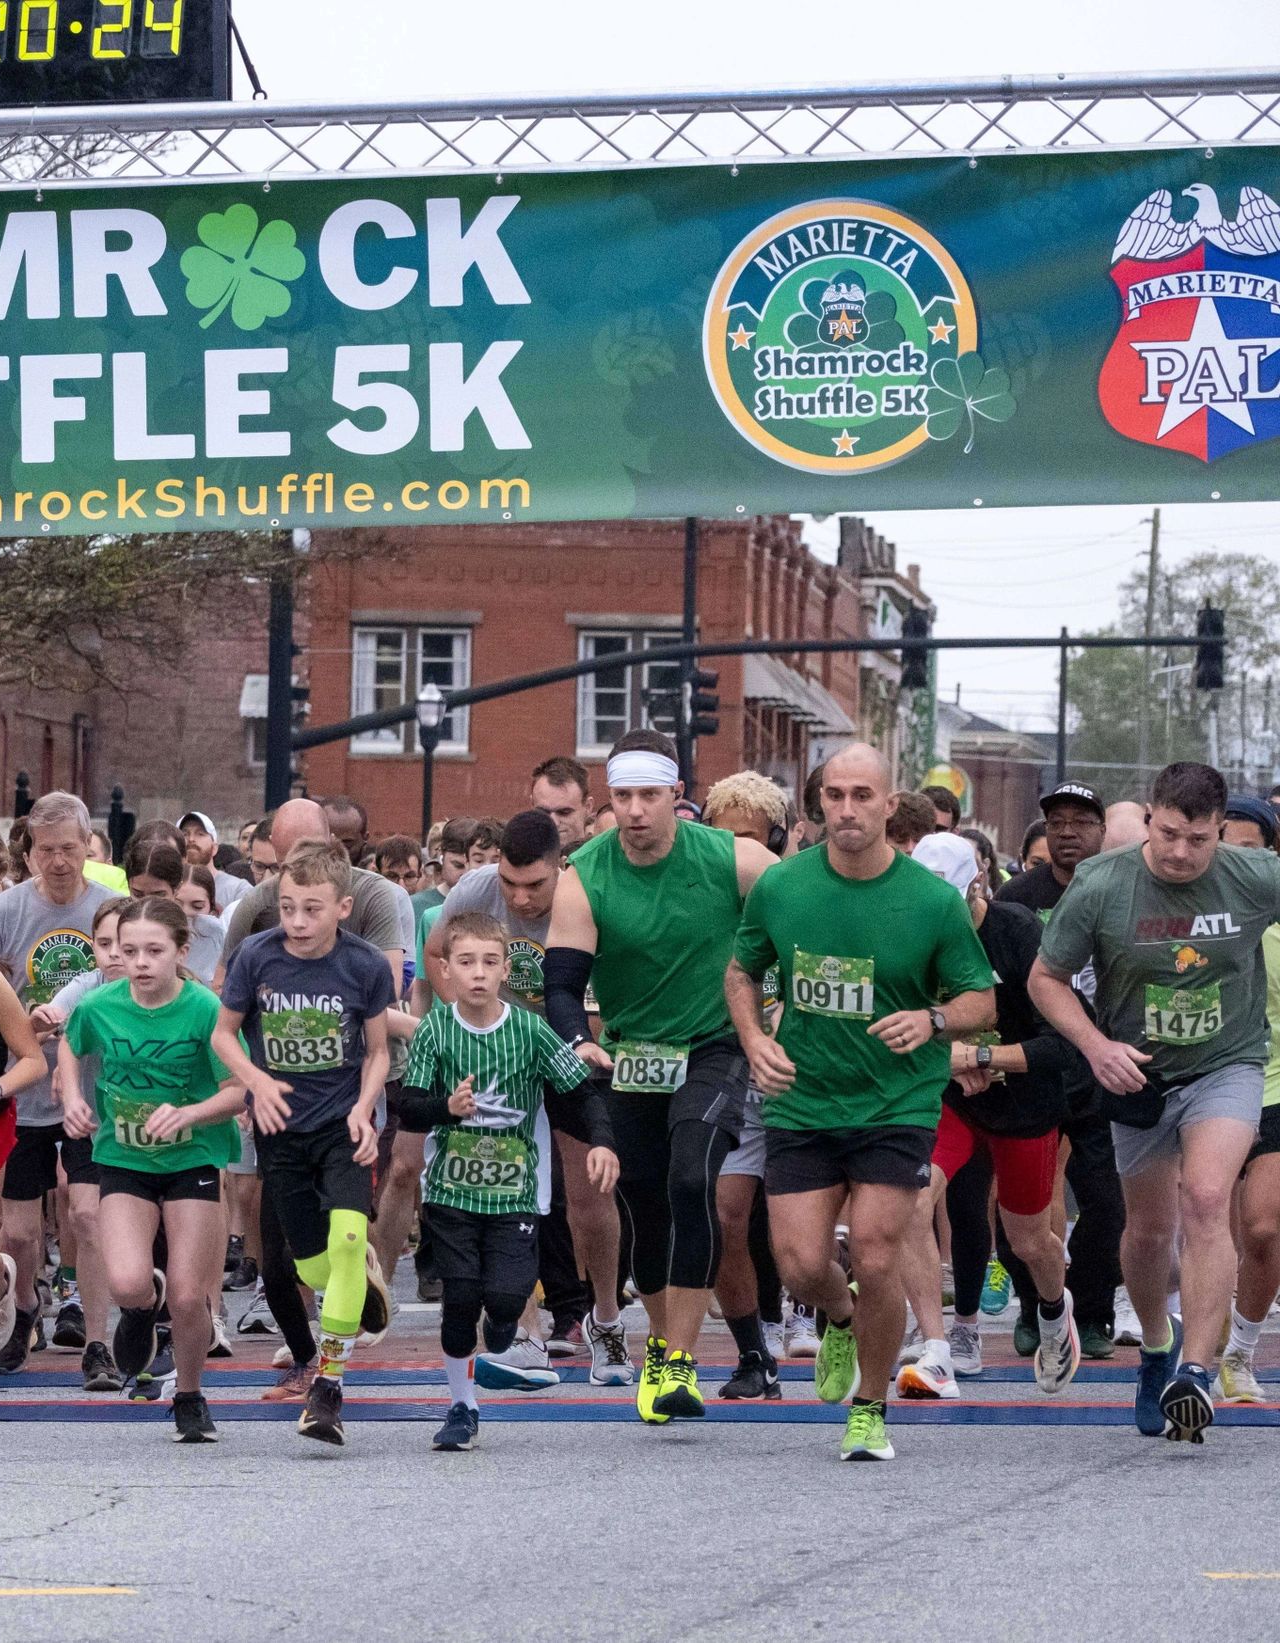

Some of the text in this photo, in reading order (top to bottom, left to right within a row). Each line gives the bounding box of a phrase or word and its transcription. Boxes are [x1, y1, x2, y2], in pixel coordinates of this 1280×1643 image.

[754, 222, 918, 281] MARIETTA
[828, 321, 862, 335] PAL
[754, 342, 927, 380] Shamrock
[326, 341, 532, 455] 5K
[754, 382, 929, 420] Shuffle 5K
[1055, 785, 1094, 799] SMC
[40, 934, 86, 952] MARIETTA
[796, 978, 864, 1011] 0911
[1150, 1008, 1219, 1038] 1475
[267, 1037, 339, 1065] 0833
[617, 1057, 683, 1085] 0837
[448, 1156, 522, 1187] 0832
